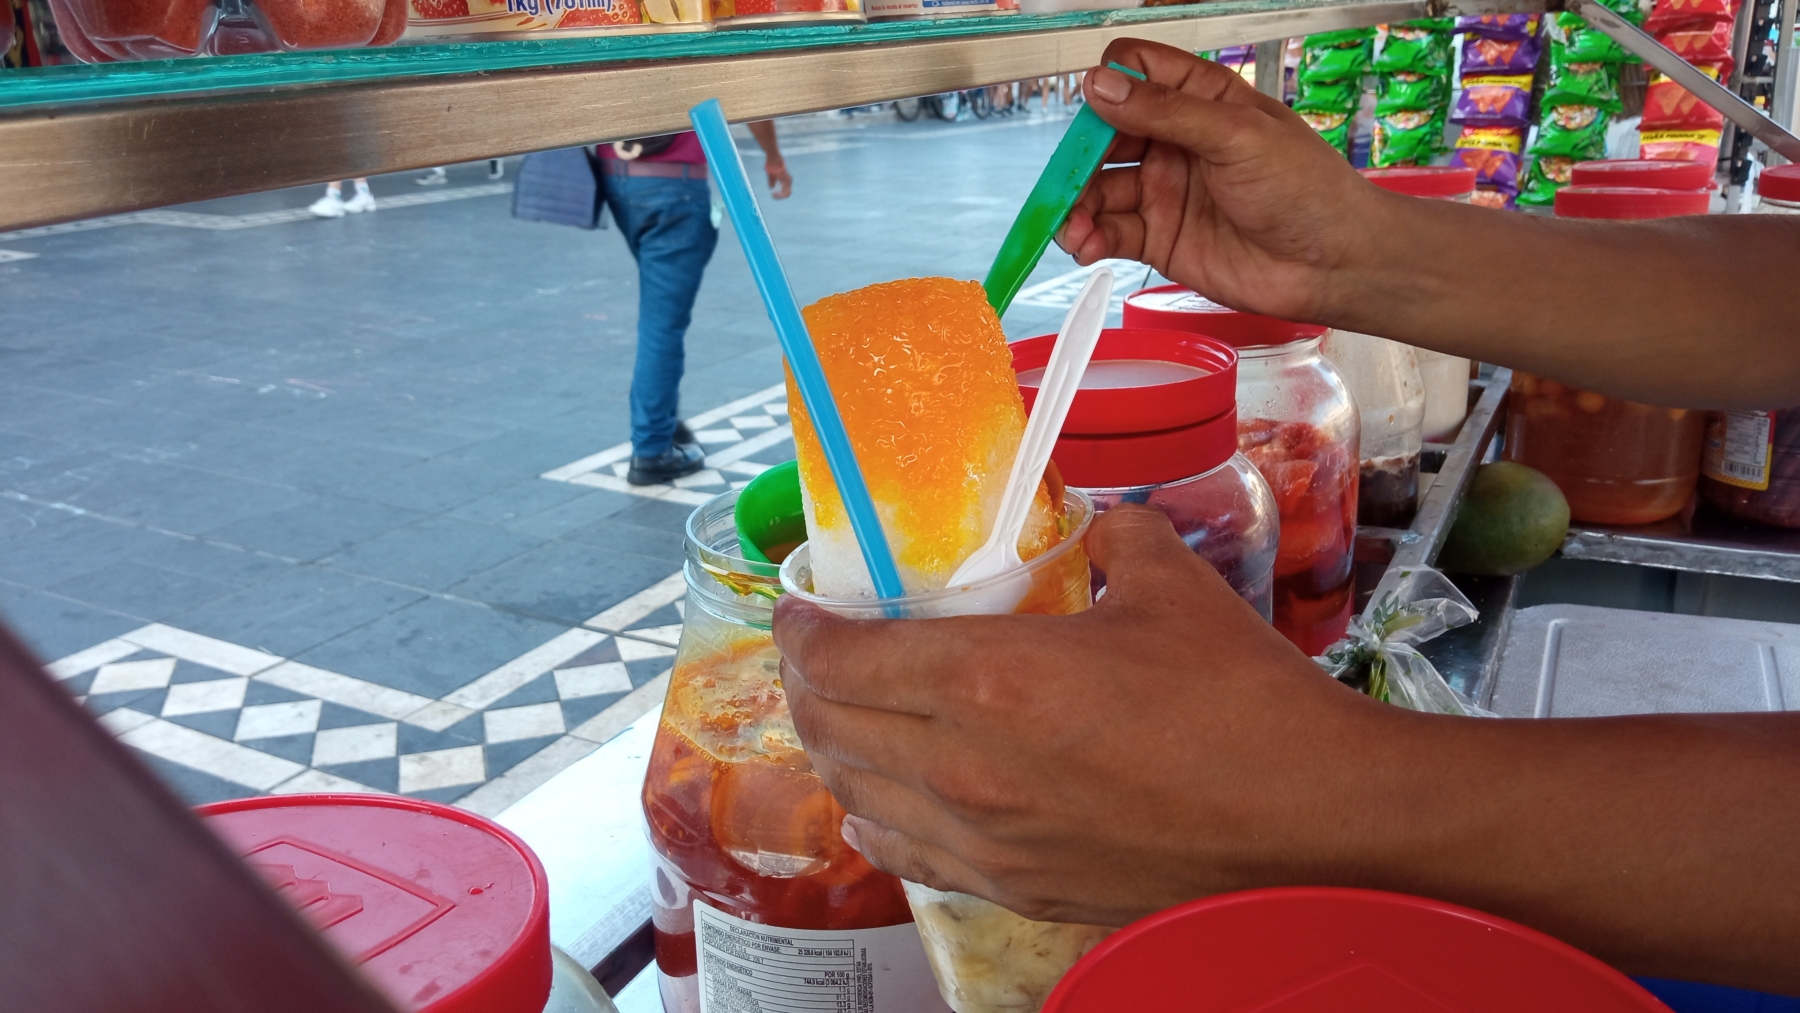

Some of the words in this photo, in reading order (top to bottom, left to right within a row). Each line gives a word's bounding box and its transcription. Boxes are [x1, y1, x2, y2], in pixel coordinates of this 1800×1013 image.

[725, 932, 751, 948] ENERGÉTICO
[752, 941, 761, 950] POR
[729, 925, 760, 940] DECLARACIÓN
[761, 934, 794, 946] NUTRIMENTAL
[726, 961, 753, 976] ENERGÉTICO
